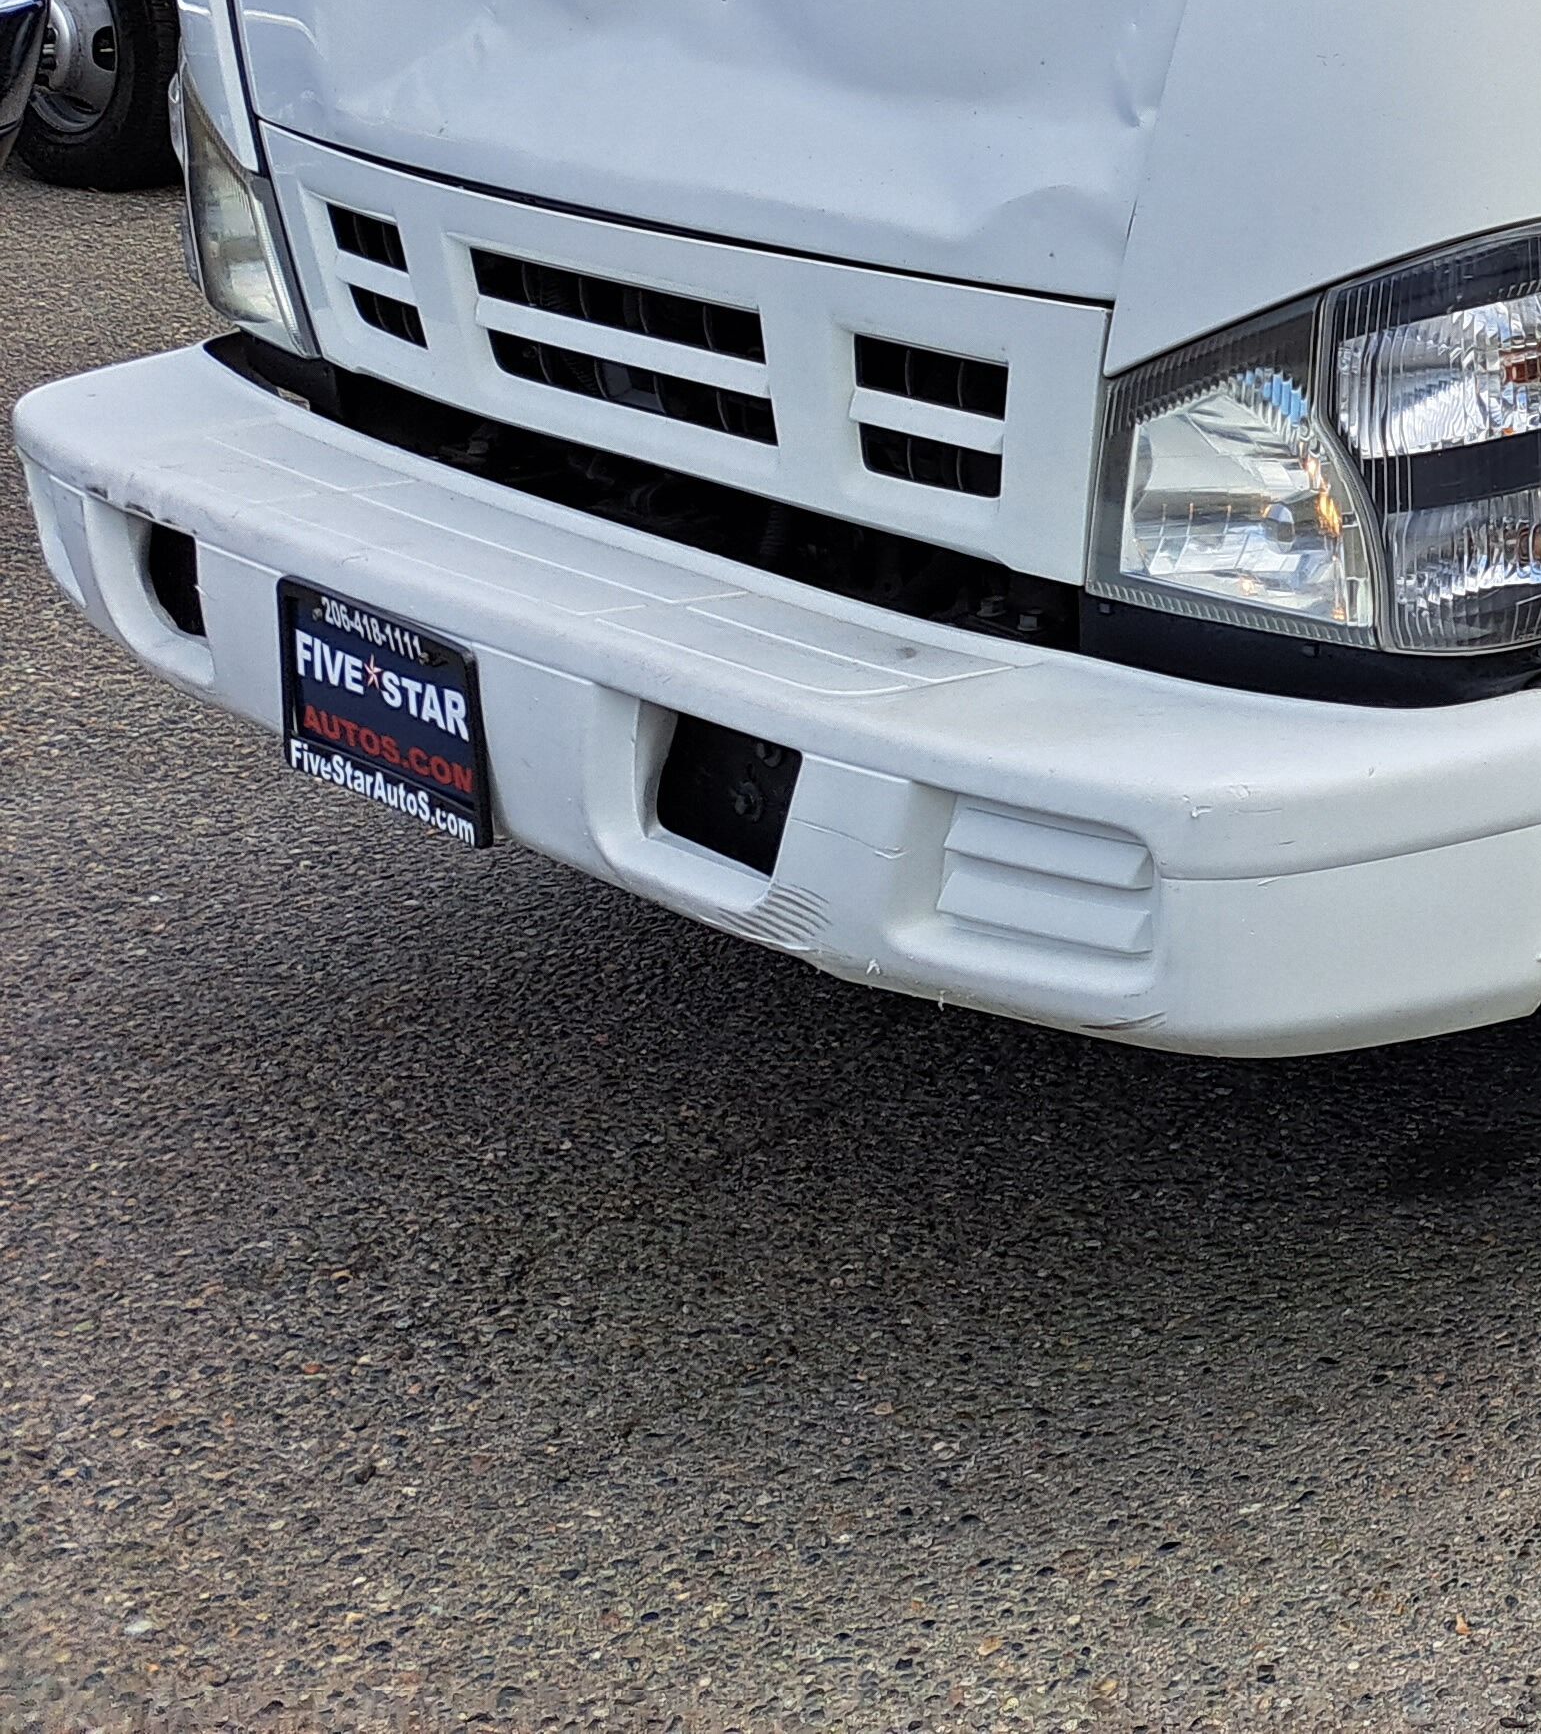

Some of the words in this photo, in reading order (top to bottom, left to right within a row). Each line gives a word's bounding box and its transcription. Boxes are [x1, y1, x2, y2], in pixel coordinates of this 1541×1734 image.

[321, 595, 422, 660] 206-418-1111
[295, 628, 365, 696] FIVE
[380, 670, 470, 743] STAR
